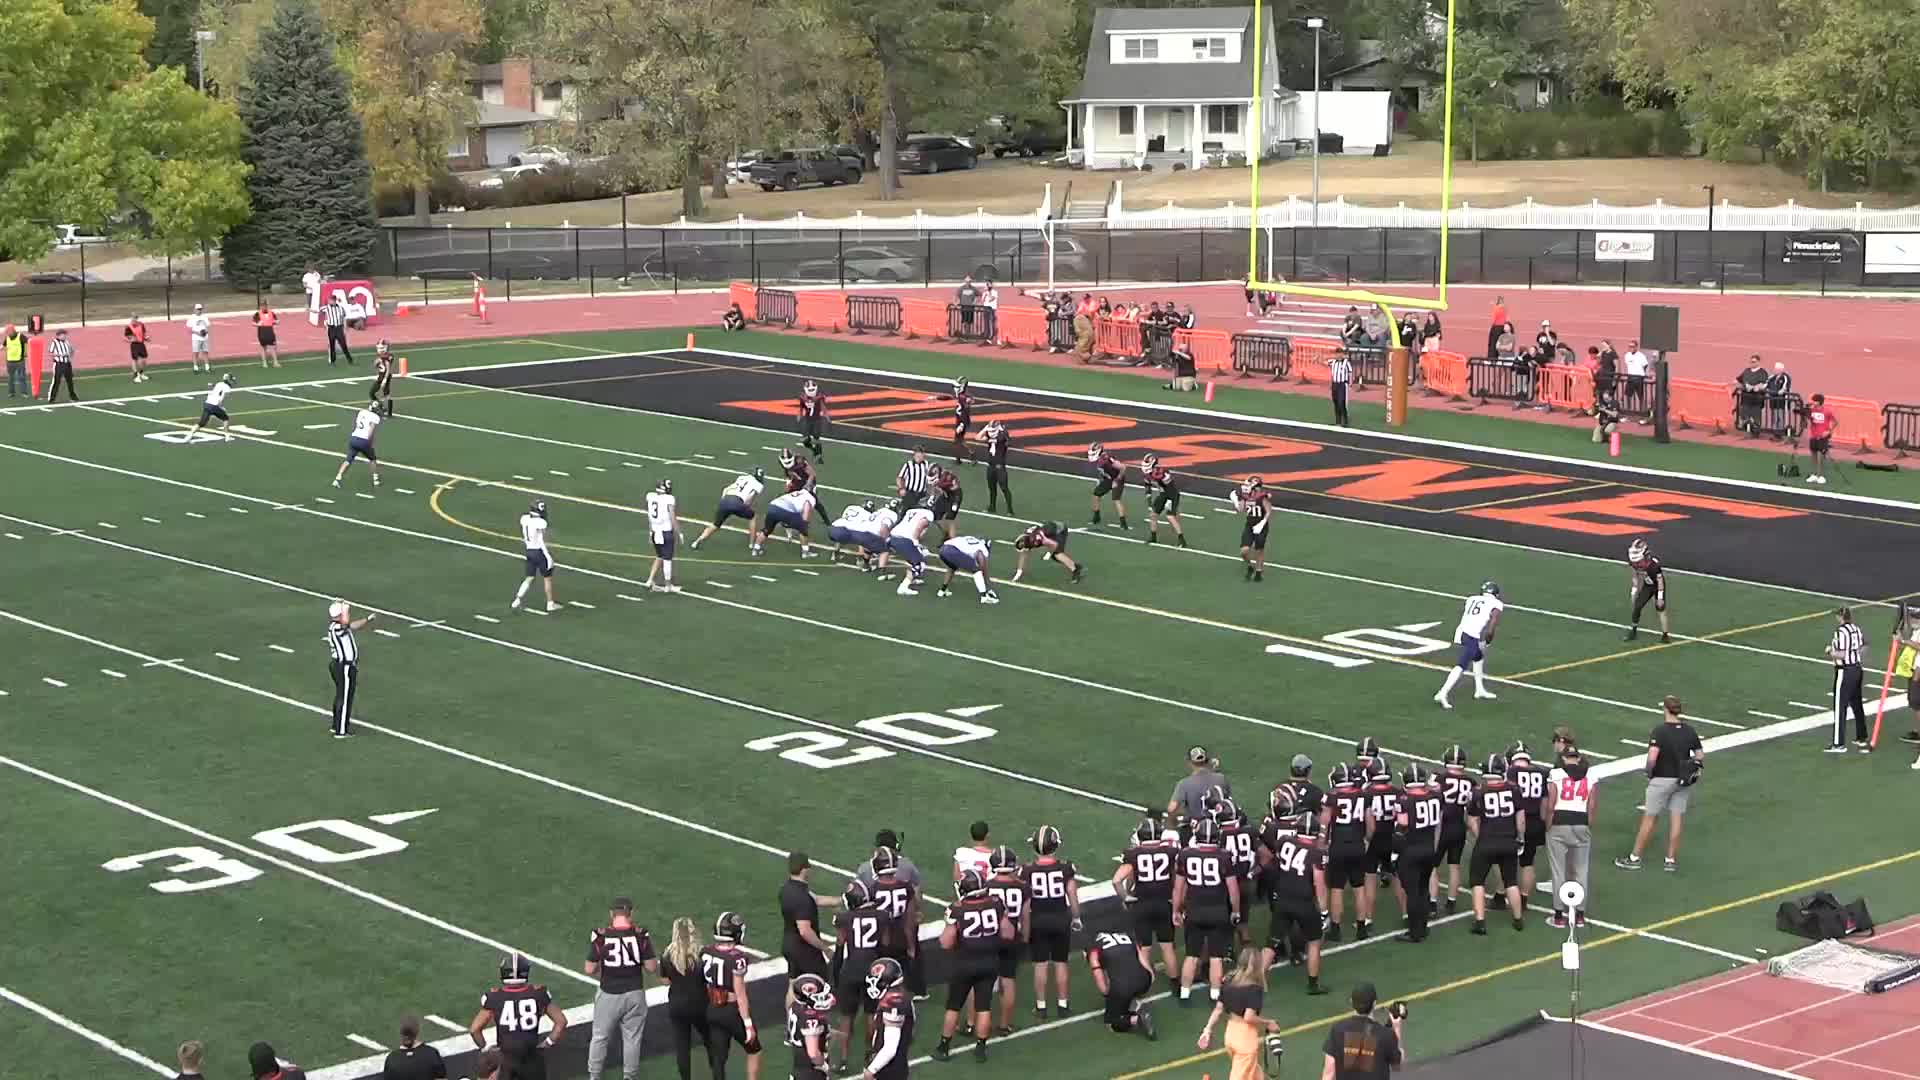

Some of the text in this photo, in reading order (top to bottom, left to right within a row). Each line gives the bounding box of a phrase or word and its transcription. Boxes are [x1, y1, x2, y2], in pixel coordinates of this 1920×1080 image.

[32, 315, 40, 330] 1
[651, 501, 658, 518] 3
[1467, 599, 1485, 615] 16
[1265, 628, 1451, 667] 10
[744, 712, 998, 768] 20
[1443, 778, 1472, 805] 28
[1517, 771, 1543, 799] 98
[1561, 776, 1588, 801] 84
[1336, 798, 1365, 824] 34
[1371, 795, 1397, 821] 45
[1416, 798, 1440, 829] 90
[1484, 791, 1514, 818] 95
[101, 819, 409, 893] 30
[1225, 833, 1251, 865] 49
[1280, 841, 1308, 876] 94
[1137, 853, 1170, 882] 92
[1186, 857, 1221, 886] 99
[1031, 872, 1065, 899] 96
[875, 888, 907, 918] 26
[853, 917, 878, 948] 12
[963, 908, 999, 938] 29
[604, 935, 640, 967] 30
[1095, 932, 1133, 950] 36
[499, 998, 538, 1032] 48
